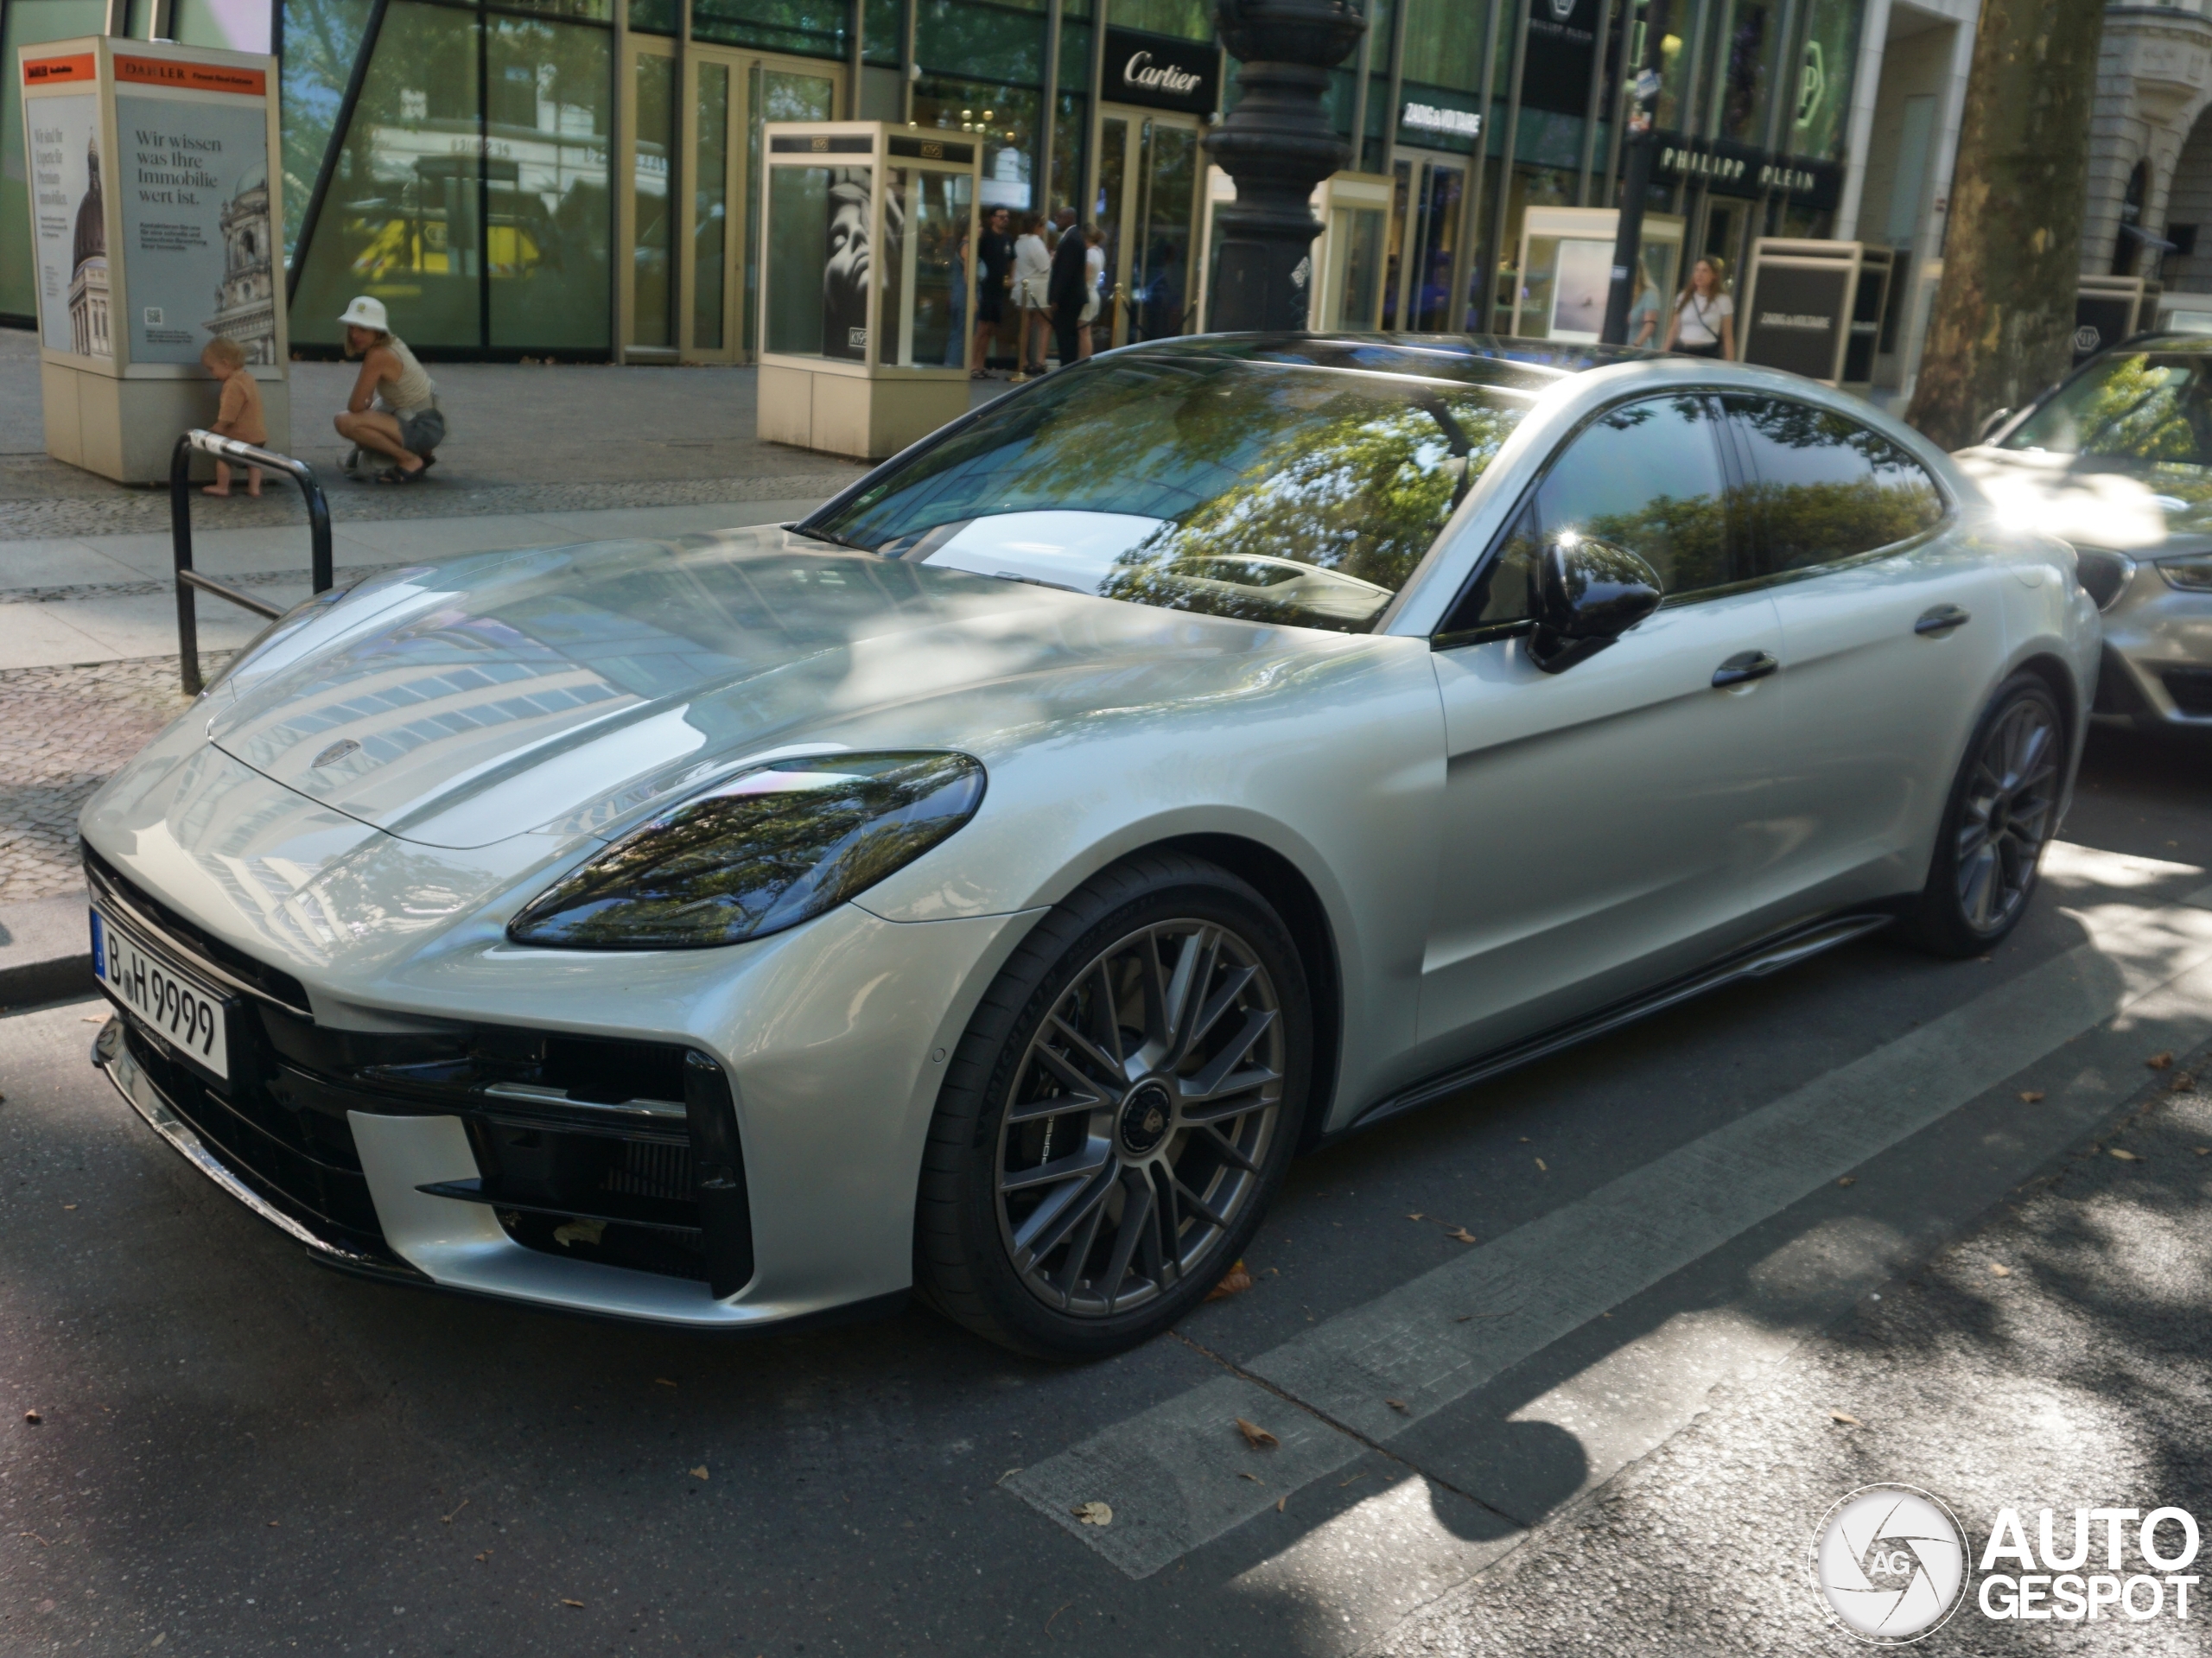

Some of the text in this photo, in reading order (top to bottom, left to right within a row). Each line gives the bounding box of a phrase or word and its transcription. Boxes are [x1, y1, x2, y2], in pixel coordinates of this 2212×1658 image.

[1124, 50, 1202, 92] Cartier
[136, 130, 221, 151] Wir wissen
[137, 151, 203, 168] was Ihre
[1662, 147, 1815, 190] PHILIPP PLEIN
[138, 168, 218, 188] Immobilie
[139, 188, 200, 205] wert ist.
